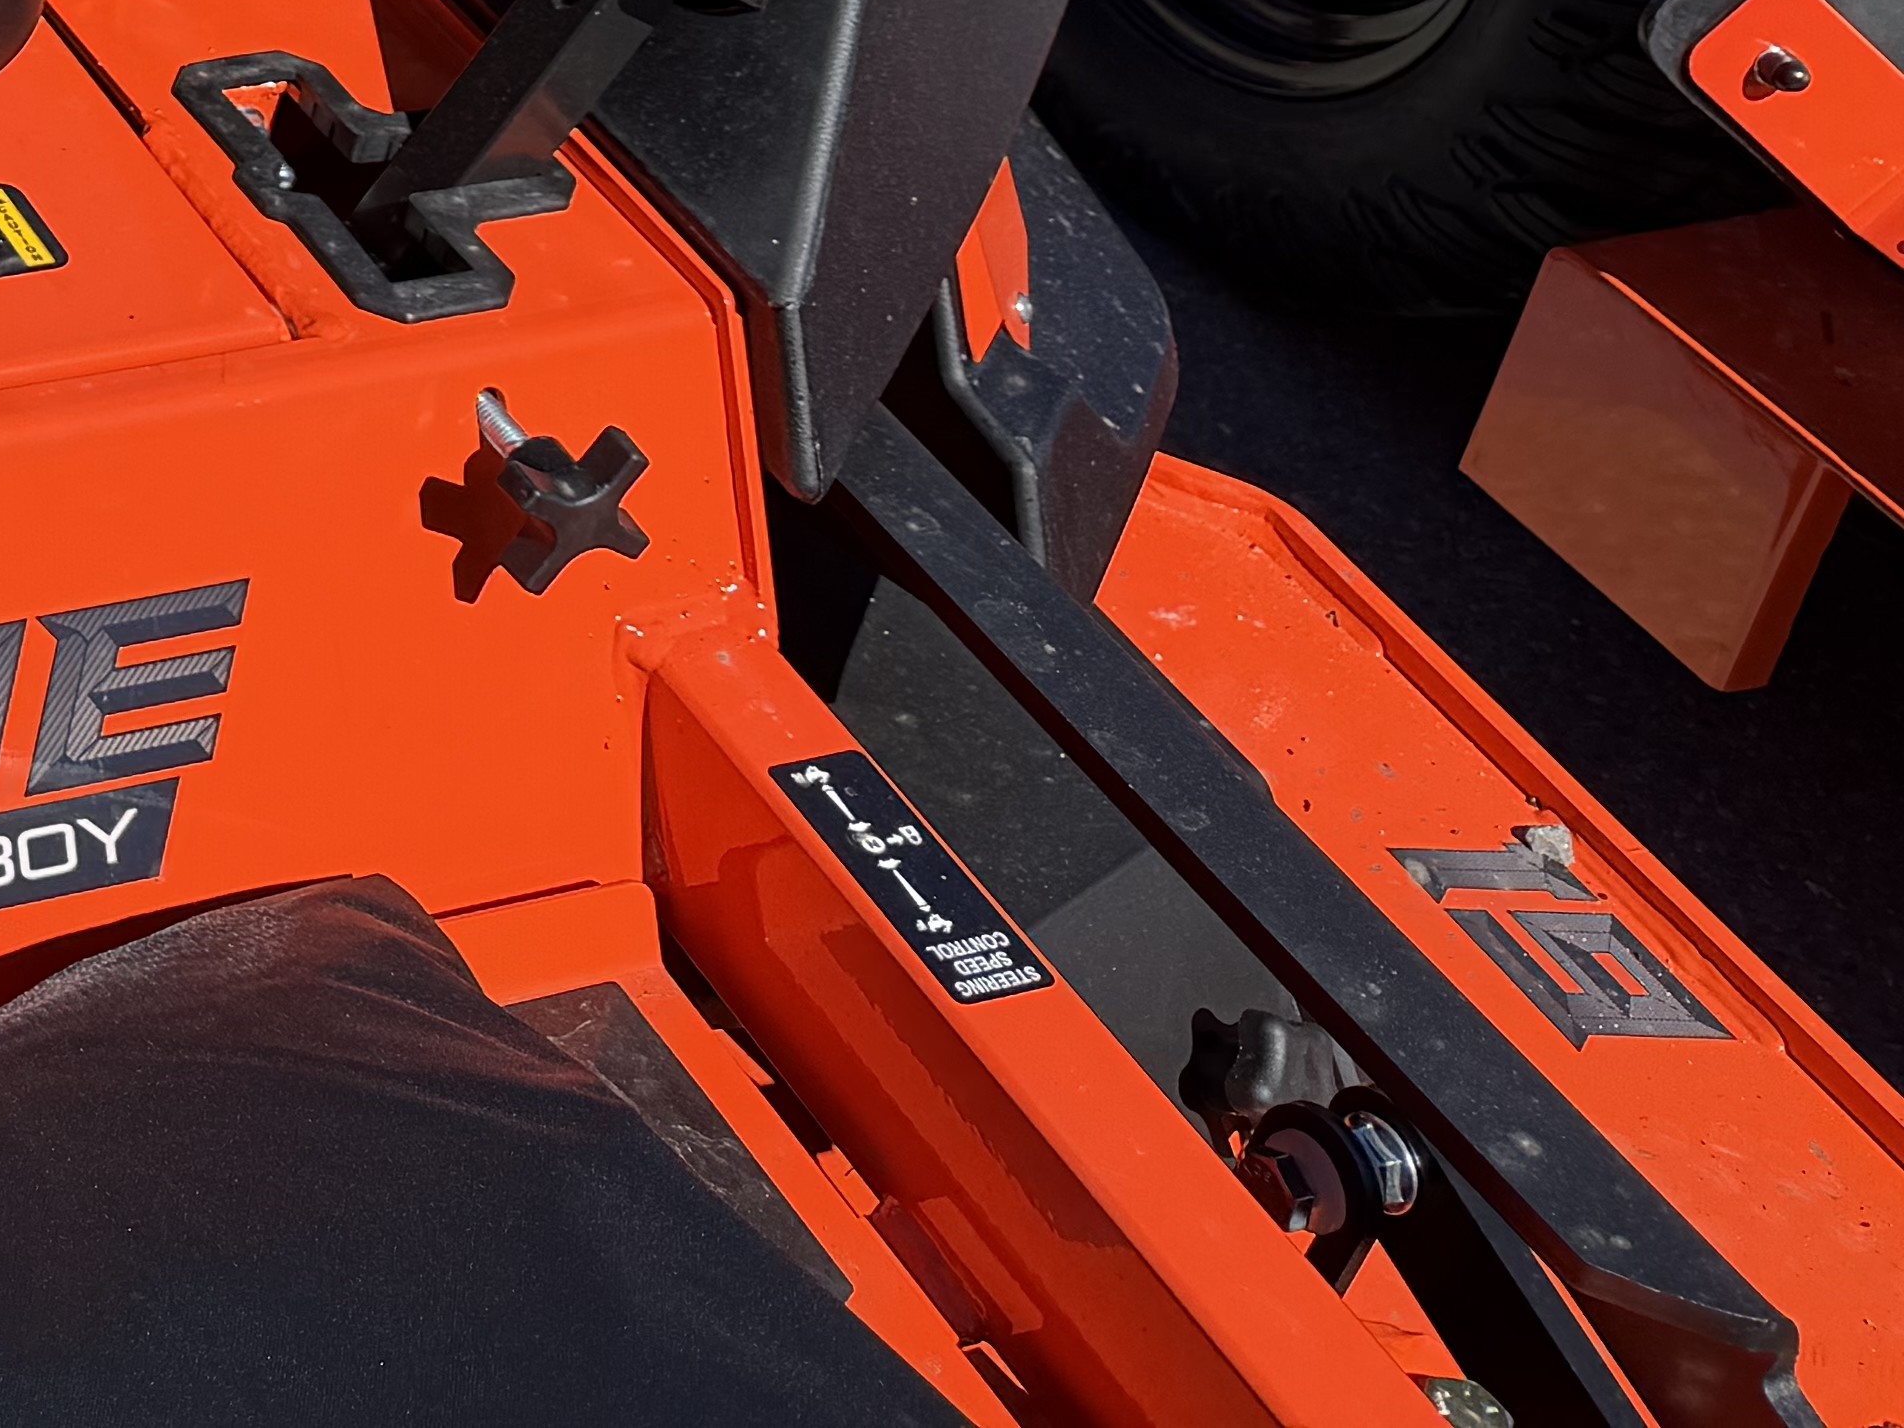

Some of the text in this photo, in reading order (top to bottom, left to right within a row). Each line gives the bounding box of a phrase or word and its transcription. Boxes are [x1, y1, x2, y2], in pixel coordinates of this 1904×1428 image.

[926, 931, 1010, 961] CONTROL
[953, 951, 1013, 976] SPEED
[954, 965, 1042, 998] STEERING
